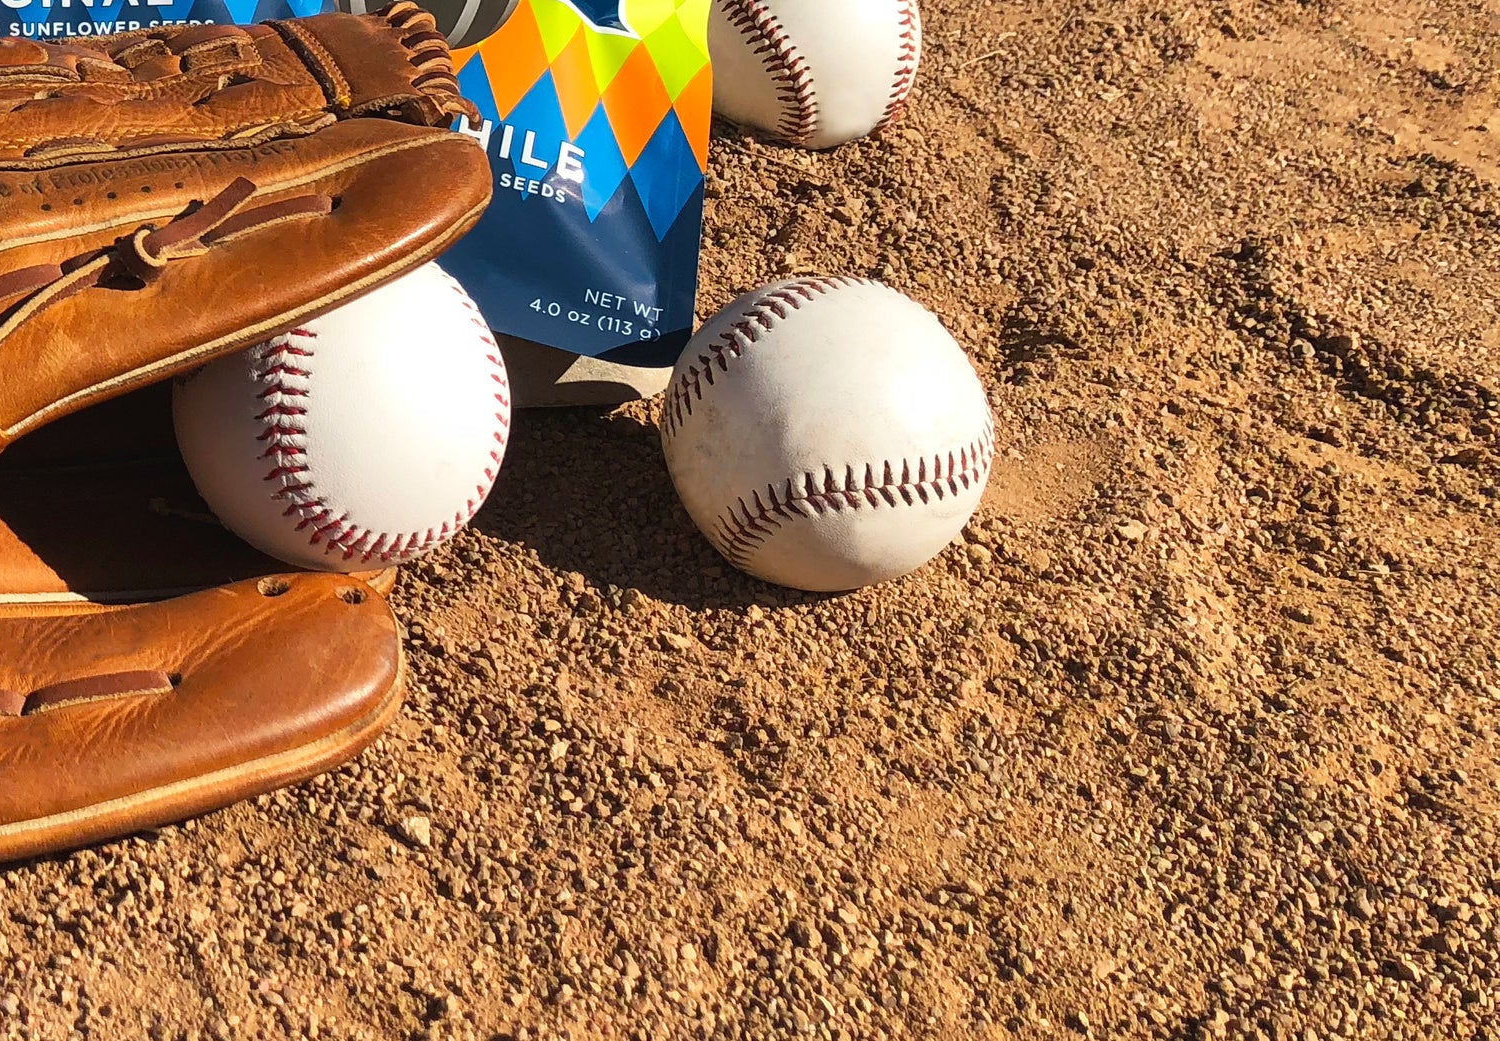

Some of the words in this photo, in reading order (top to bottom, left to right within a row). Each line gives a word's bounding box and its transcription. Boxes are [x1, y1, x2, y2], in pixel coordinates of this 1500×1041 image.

[458, 113, 586, 184] HILE
[19, 175, 45, 195] of
[499, 172, 566, 203] SEEDS
[529, 297, 561, 317] 4.0
[567, 310, 590, 325] oz
[597, 314, 632, 337] (113
[584, 288, 627, 311] NET
[633, 300, 664, 322] WT
